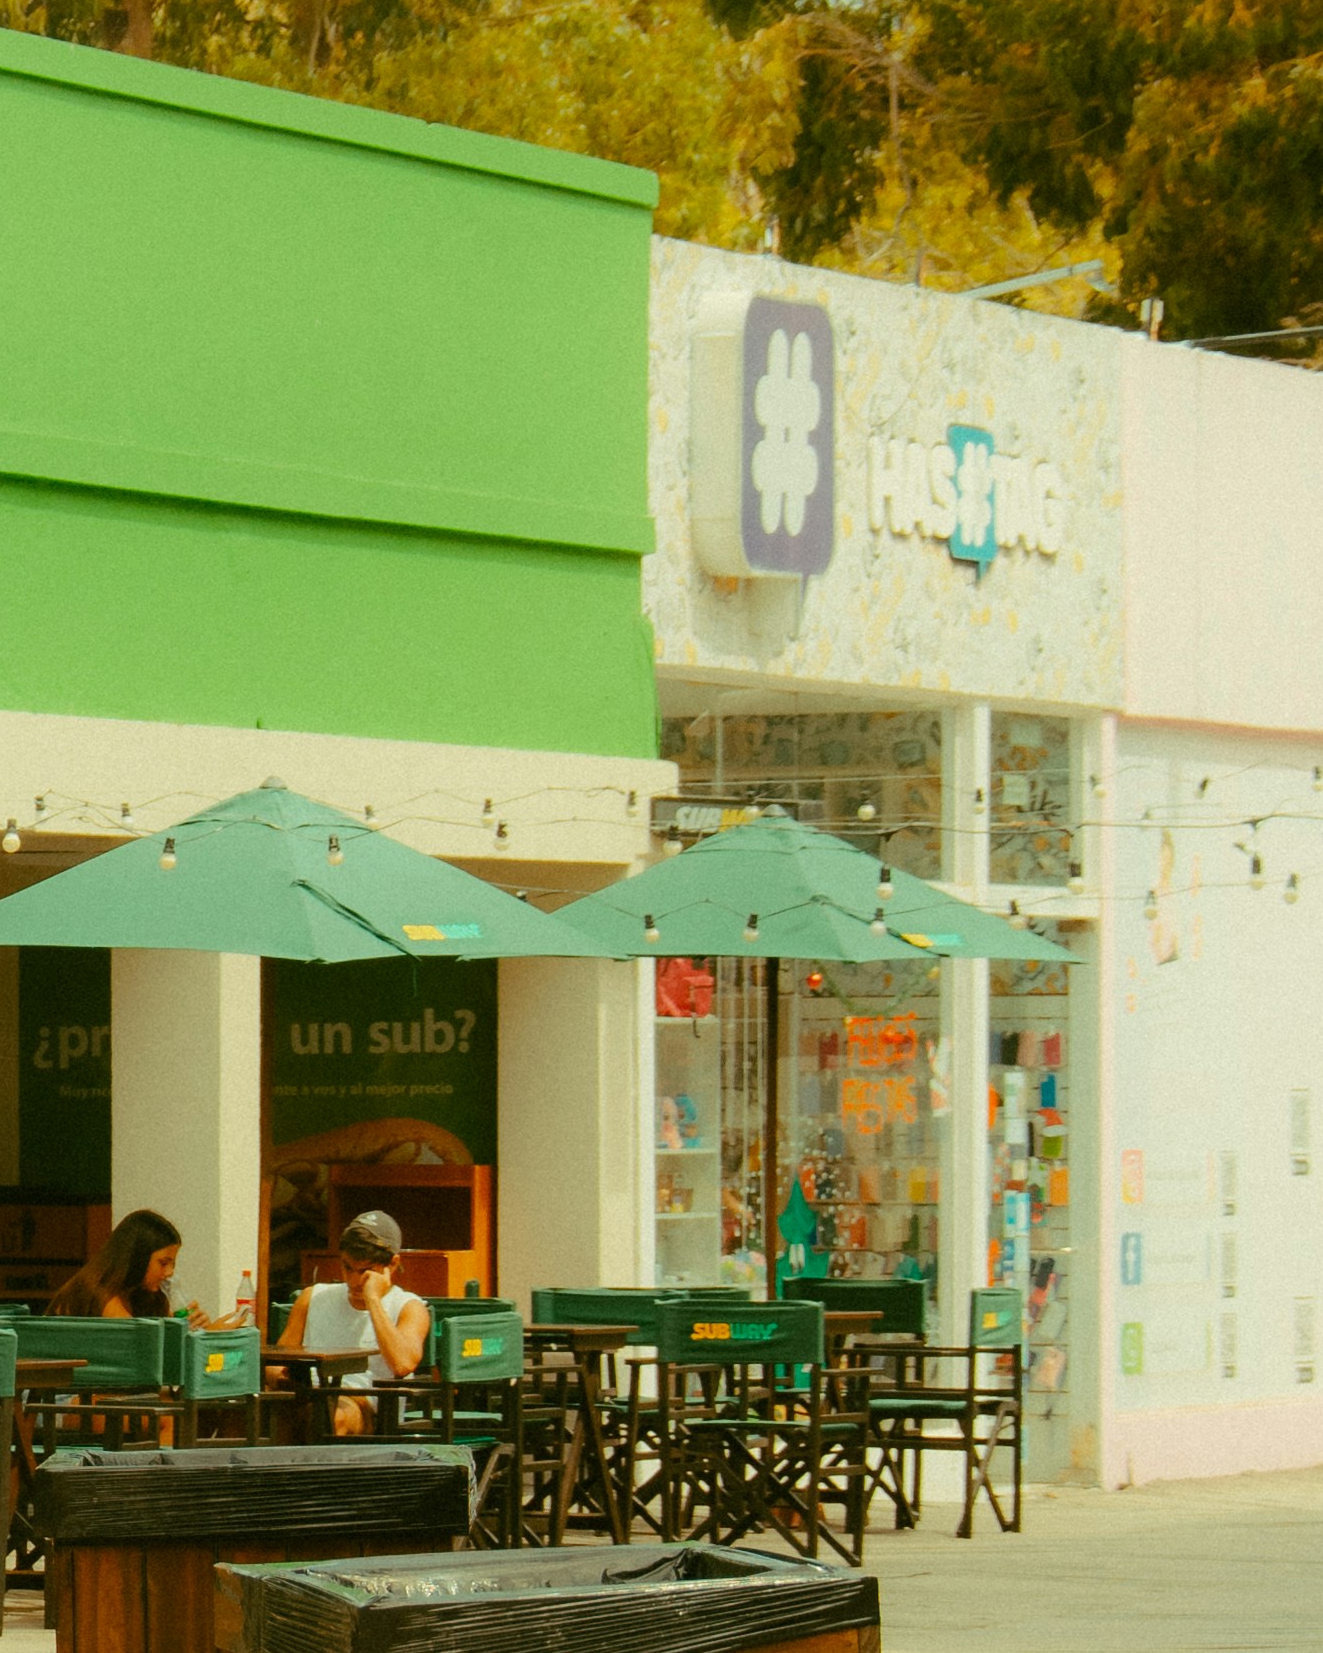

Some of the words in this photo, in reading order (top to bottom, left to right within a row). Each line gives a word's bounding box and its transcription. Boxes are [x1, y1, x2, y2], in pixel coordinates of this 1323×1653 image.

[290, 1021, 352, 1054] un
[368, 1008, 476, 1054] sub?
[366, 1082, 406, 1098] mejor
[409, 1082, 454, 1097] precio
[690, 1322, 779, 1340] SUBWAY
